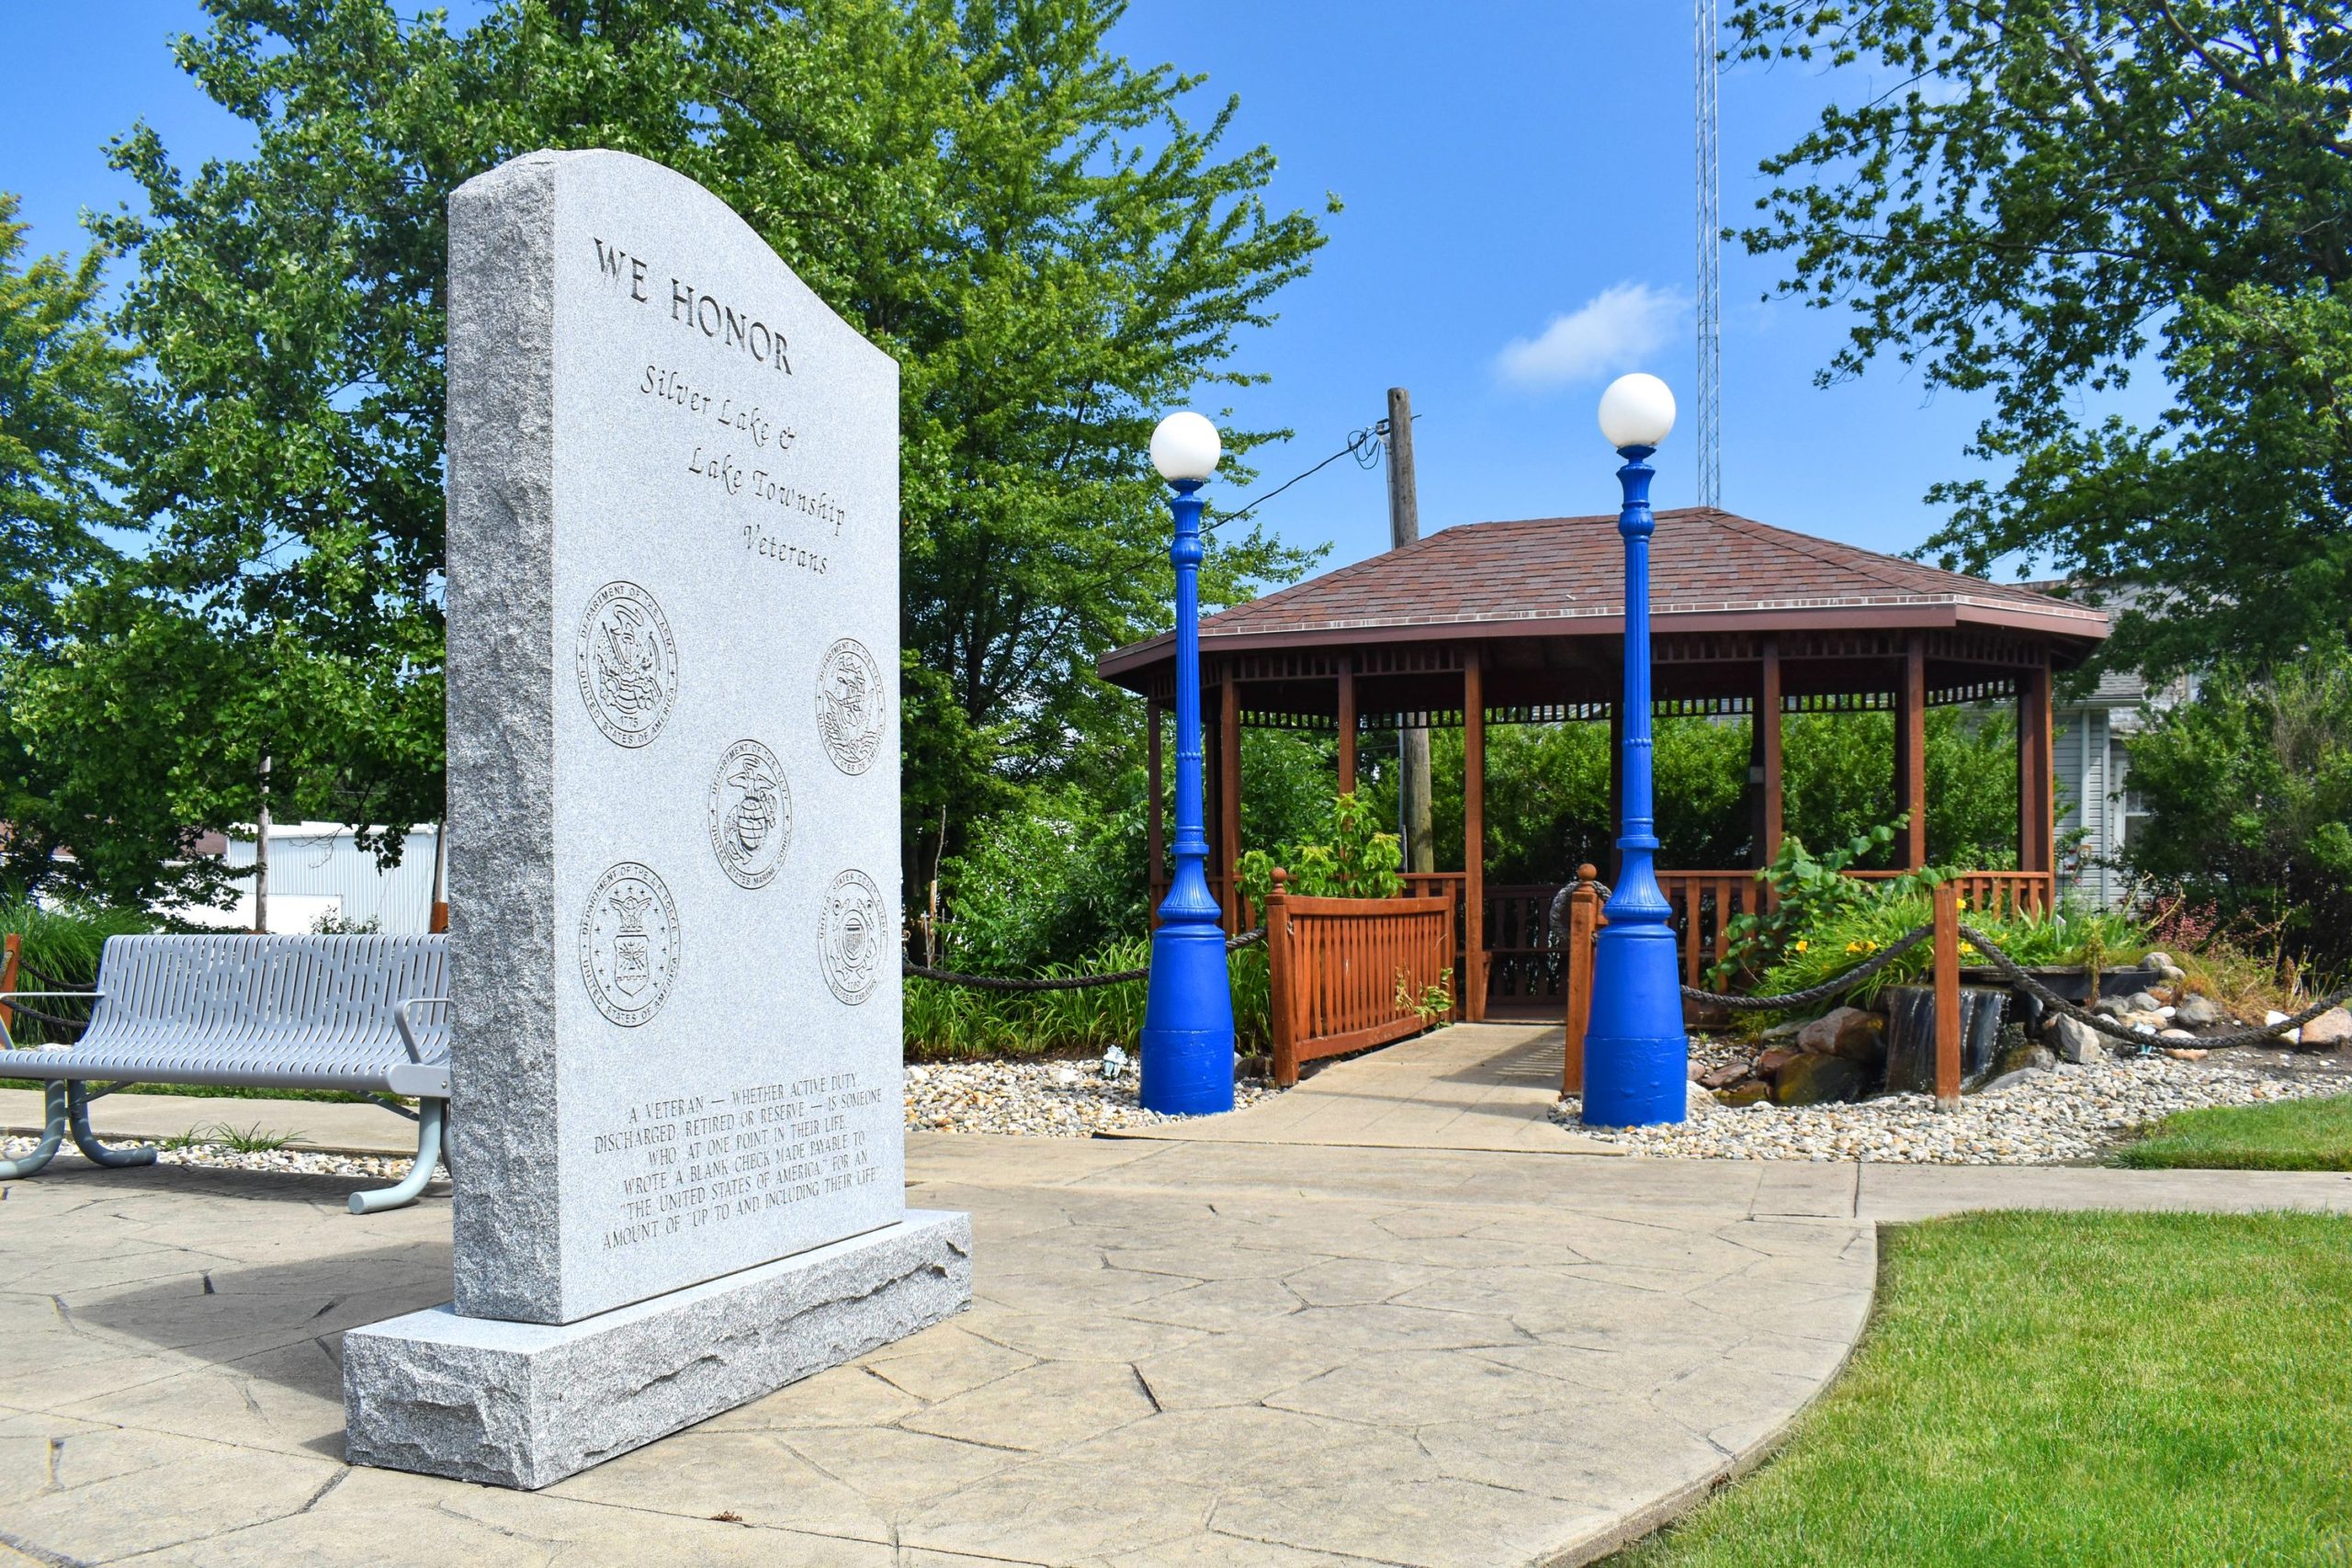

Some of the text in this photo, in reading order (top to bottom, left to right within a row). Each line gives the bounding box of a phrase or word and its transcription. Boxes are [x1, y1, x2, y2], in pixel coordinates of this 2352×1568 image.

[594, 237, 792, 376] WE HONOR
[640, 366, 797, 450] Silver Lake &
[688, 447, 844, 536] Lake Township
[743, 524, 827, 574] Veterans
[581, 585, 625, 638] DEPARTMENT
[580, 671, 600, 719] UNITED
[603, 721, 634, 744] STATES
[582, 871, 617, 935] DEPARTMENT
[583, 959, 603, 1006] UNITED
[629, 1107, 637, 1123] A
[645, 1096, 704, 1119] VETERAN
[732, 1084, 784, 1106] WHETHER
[791, 1077, 826, 1097] ACTIVE
[685, 1114, 735, 1137] RETIRED
[741, 1111, 753, 1127] OR
[761, 1102, 804, 1123] RESERVE
[828, 1096, 837, 1111] IS
[842, 1089, 882, 1109] SOMEONE
[624, 1131, 865, 1195] WROTE A BLANK CHECK MADE PAYABLE TO
[688, 1142, 701, 1159] AT
[707, 1136, 729, 1156] ONE
[736, 1130, 768, 1149] POINT
[775, 1126, 785, 1143] IN
[791, 1120, 820, 1139] THEIR
[603, 1220, 659, 1250] AMOUNT
[666, 1214, 680, 1234] OF
[714, 1203, 729, 1223] TO
[737, 1196, 760, 1216] AND
[765, 1181, 820, 1209] INCLUDING
[824, 1173, 853, 1193] THEIR
[660, 1187, 706, 1212] UNITED
[712, 1176, 751, 1200] STATES
[757, 1172, 770, 1190] OF
[832, 1154, 849, 1171] FOR
[854, 1149, 868, 1166] AN
